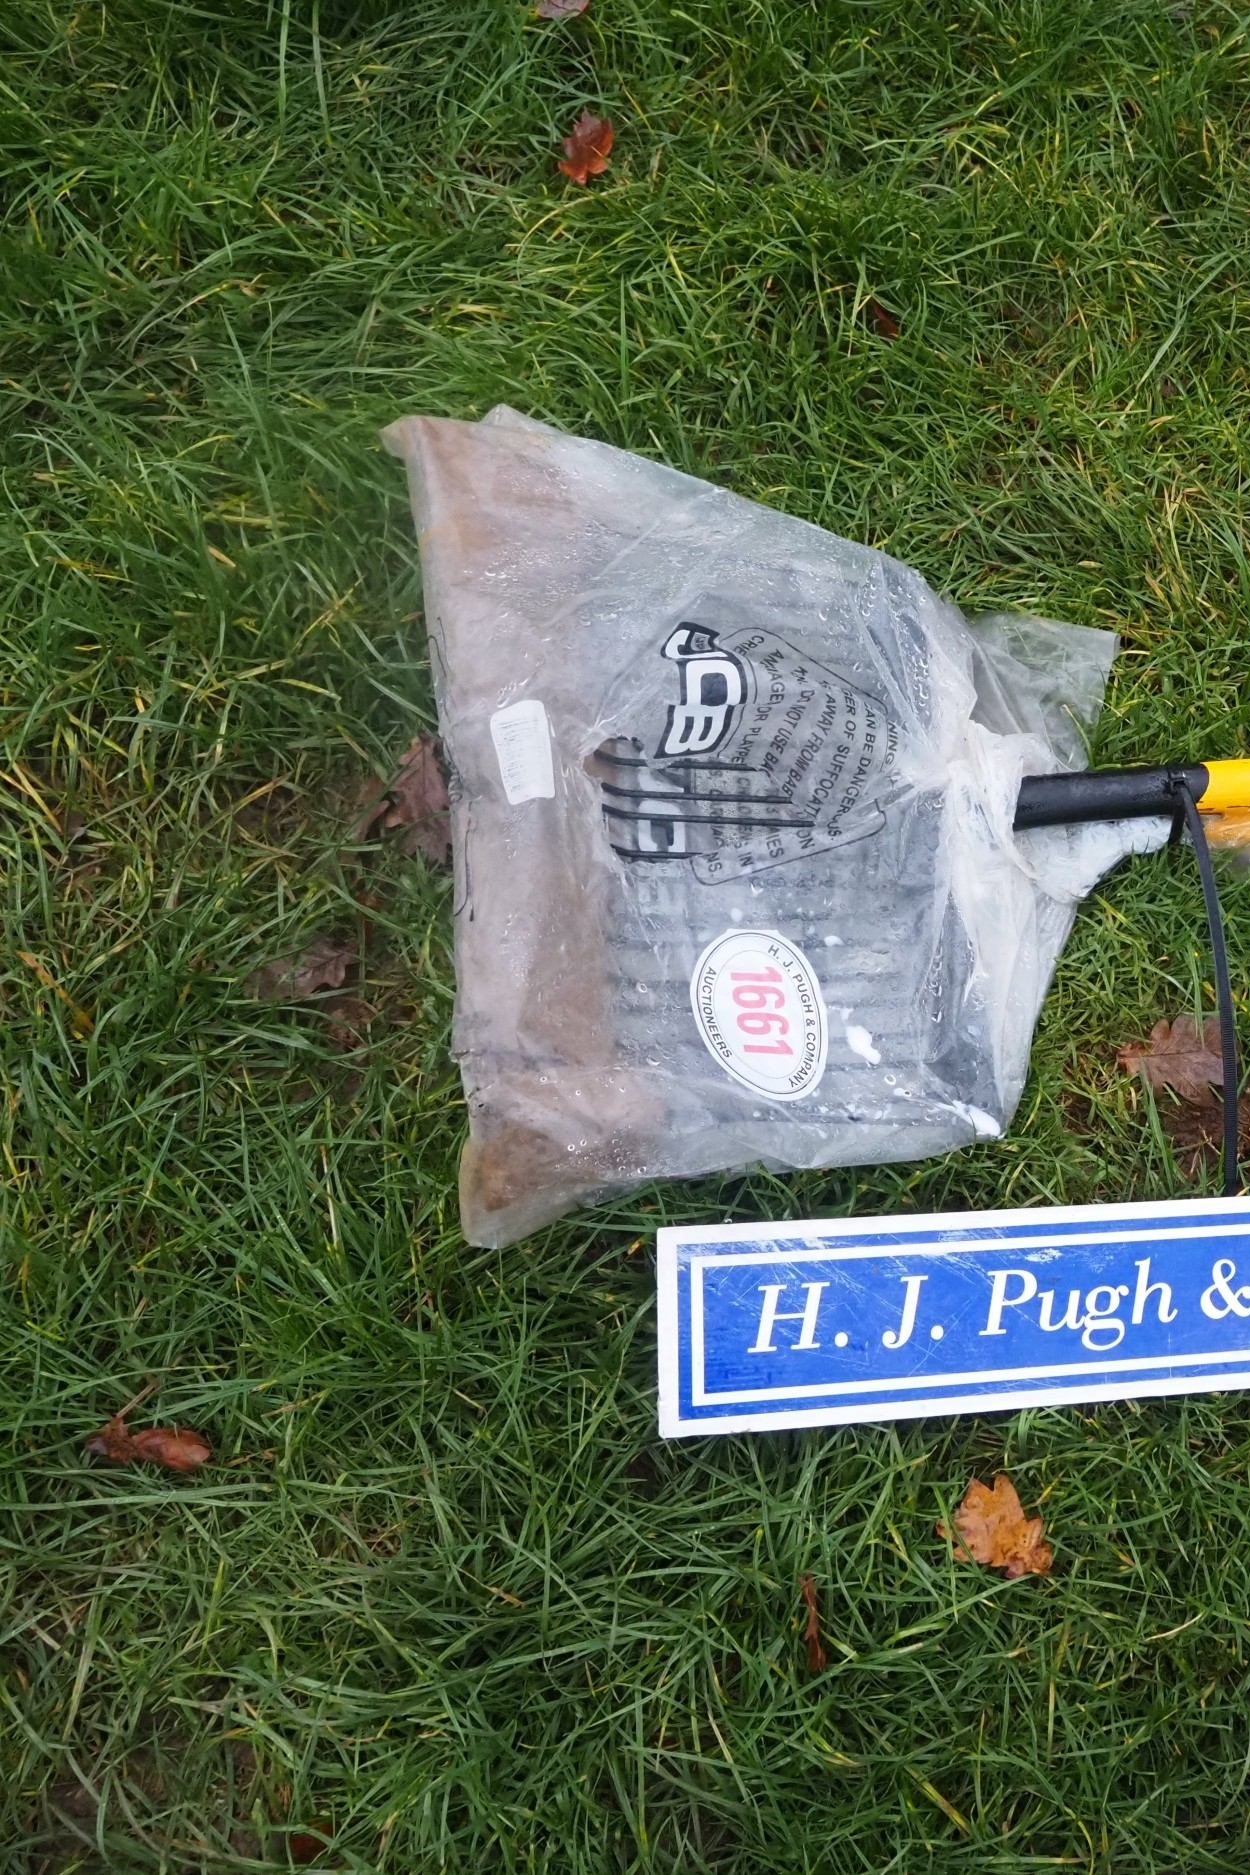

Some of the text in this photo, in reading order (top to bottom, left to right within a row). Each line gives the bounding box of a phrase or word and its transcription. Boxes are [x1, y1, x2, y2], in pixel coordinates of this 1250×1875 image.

[664, 629, 742, 755] JCB
[785, 697, 810, 730] NOT
[816, 693, 837, 735] AWAY
[842, 720, 857, 742] OF
[770, 727, 793, 755] USE
[794, 731, 825, 770] FROM
[863, 733, 877, 756] BE
[702, 966, 733, 1058] AUCTIONEERS
[730, 966, 794, 1056] 1661
[767, 944, 816, 1088] H. J. PUGH & COMPANY
[747, 1281, 848, 1353] H.
[882, 1275, 945, 1350] J.
[979, 1257, 1178, 1351] Pugh
